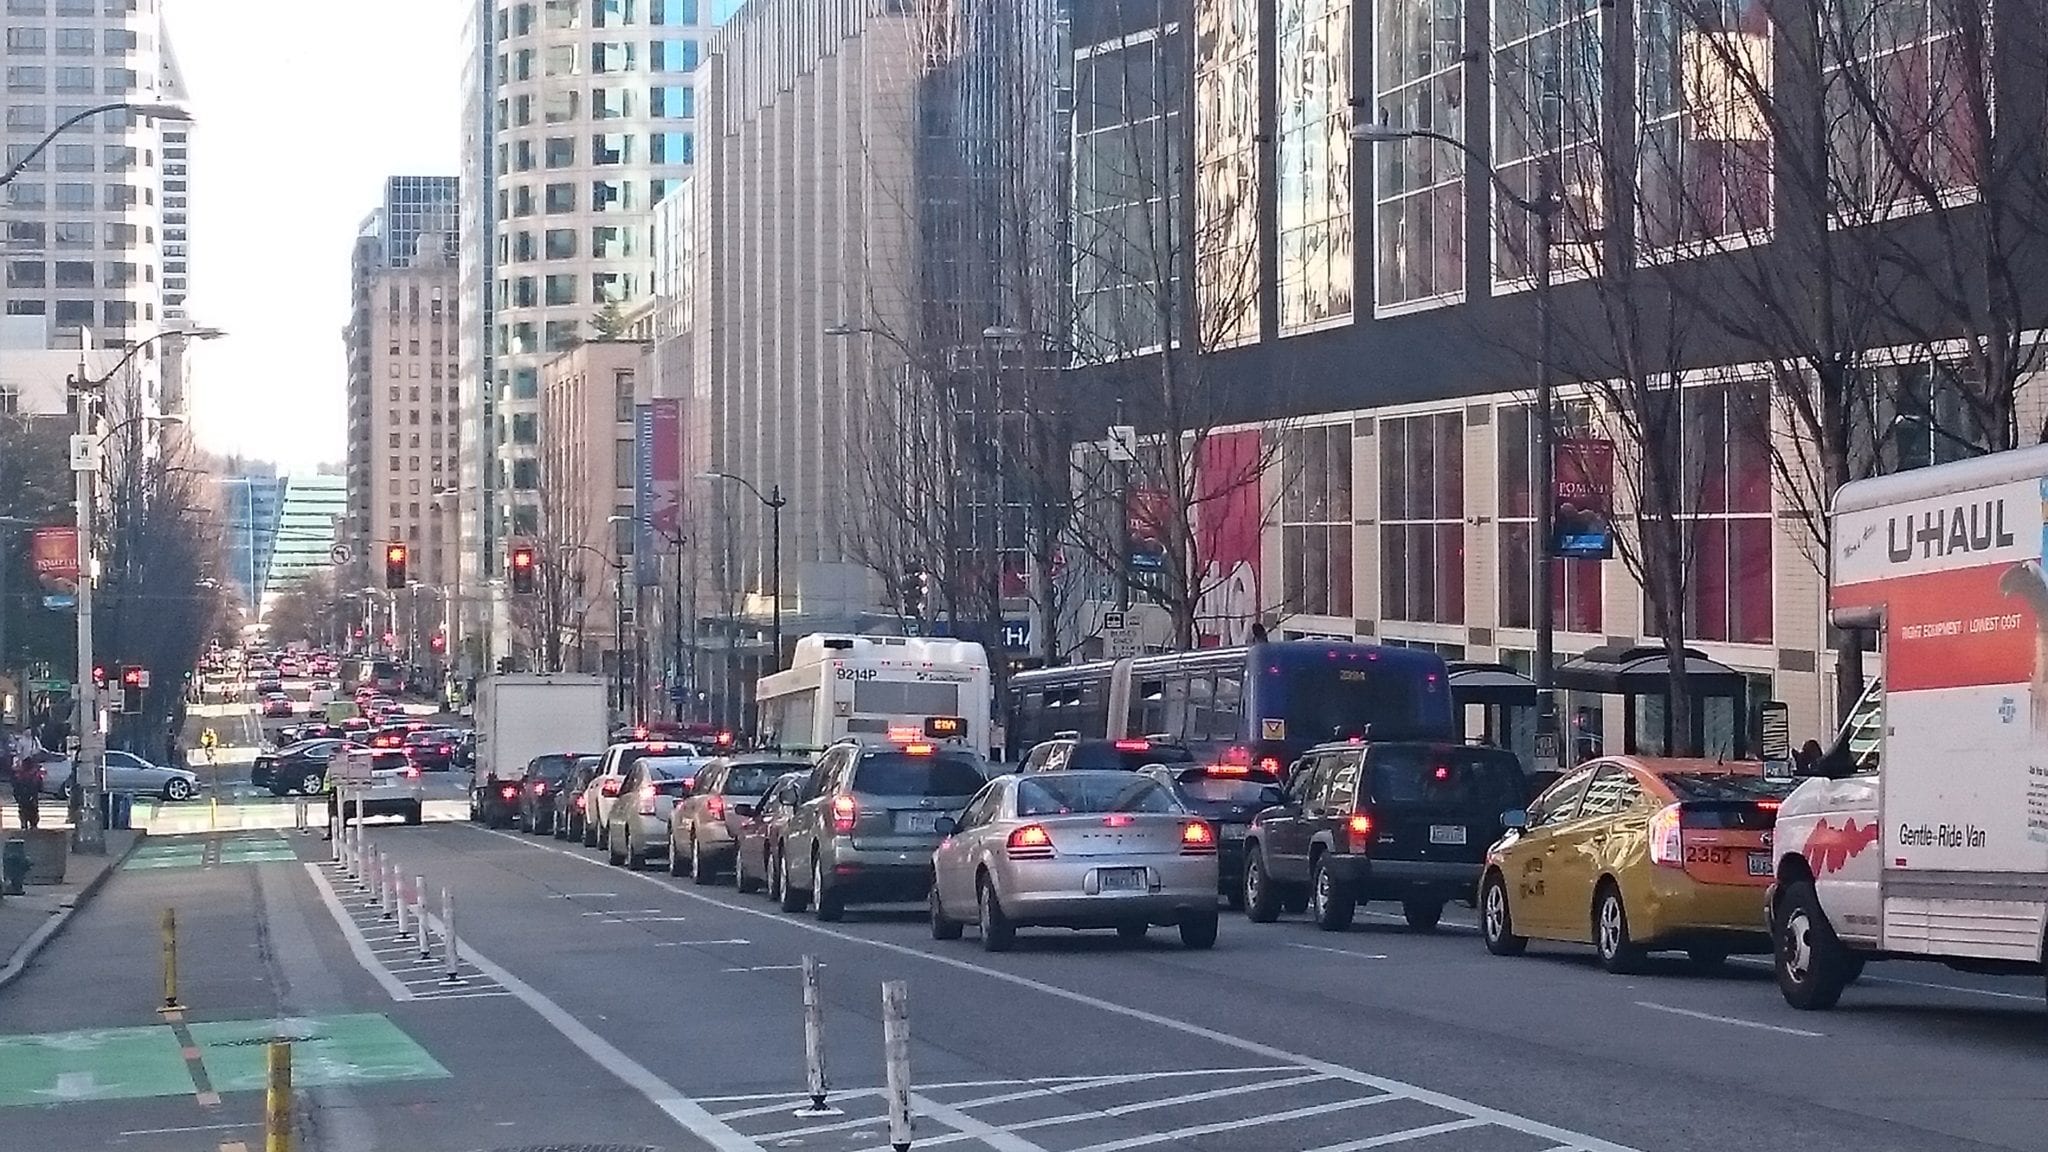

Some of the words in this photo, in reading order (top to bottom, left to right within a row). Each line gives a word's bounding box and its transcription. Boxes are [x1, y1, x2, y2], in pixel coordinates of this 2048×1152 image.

[1888, 499, 2014, 563] U-HAUL
[1901, 625, 1922, 640] RIGHT
[1923, 620, 1961, 638] EQUIPMENT
[1969, 616, 2000, 633] LOWEST
[2001, 614, 2022, 630] COST
[836, 668, 877, 680] 9214P
[1900, 823, 1962, 848] Gentle-Ride
[1966, 824, 1986, 848] Van
